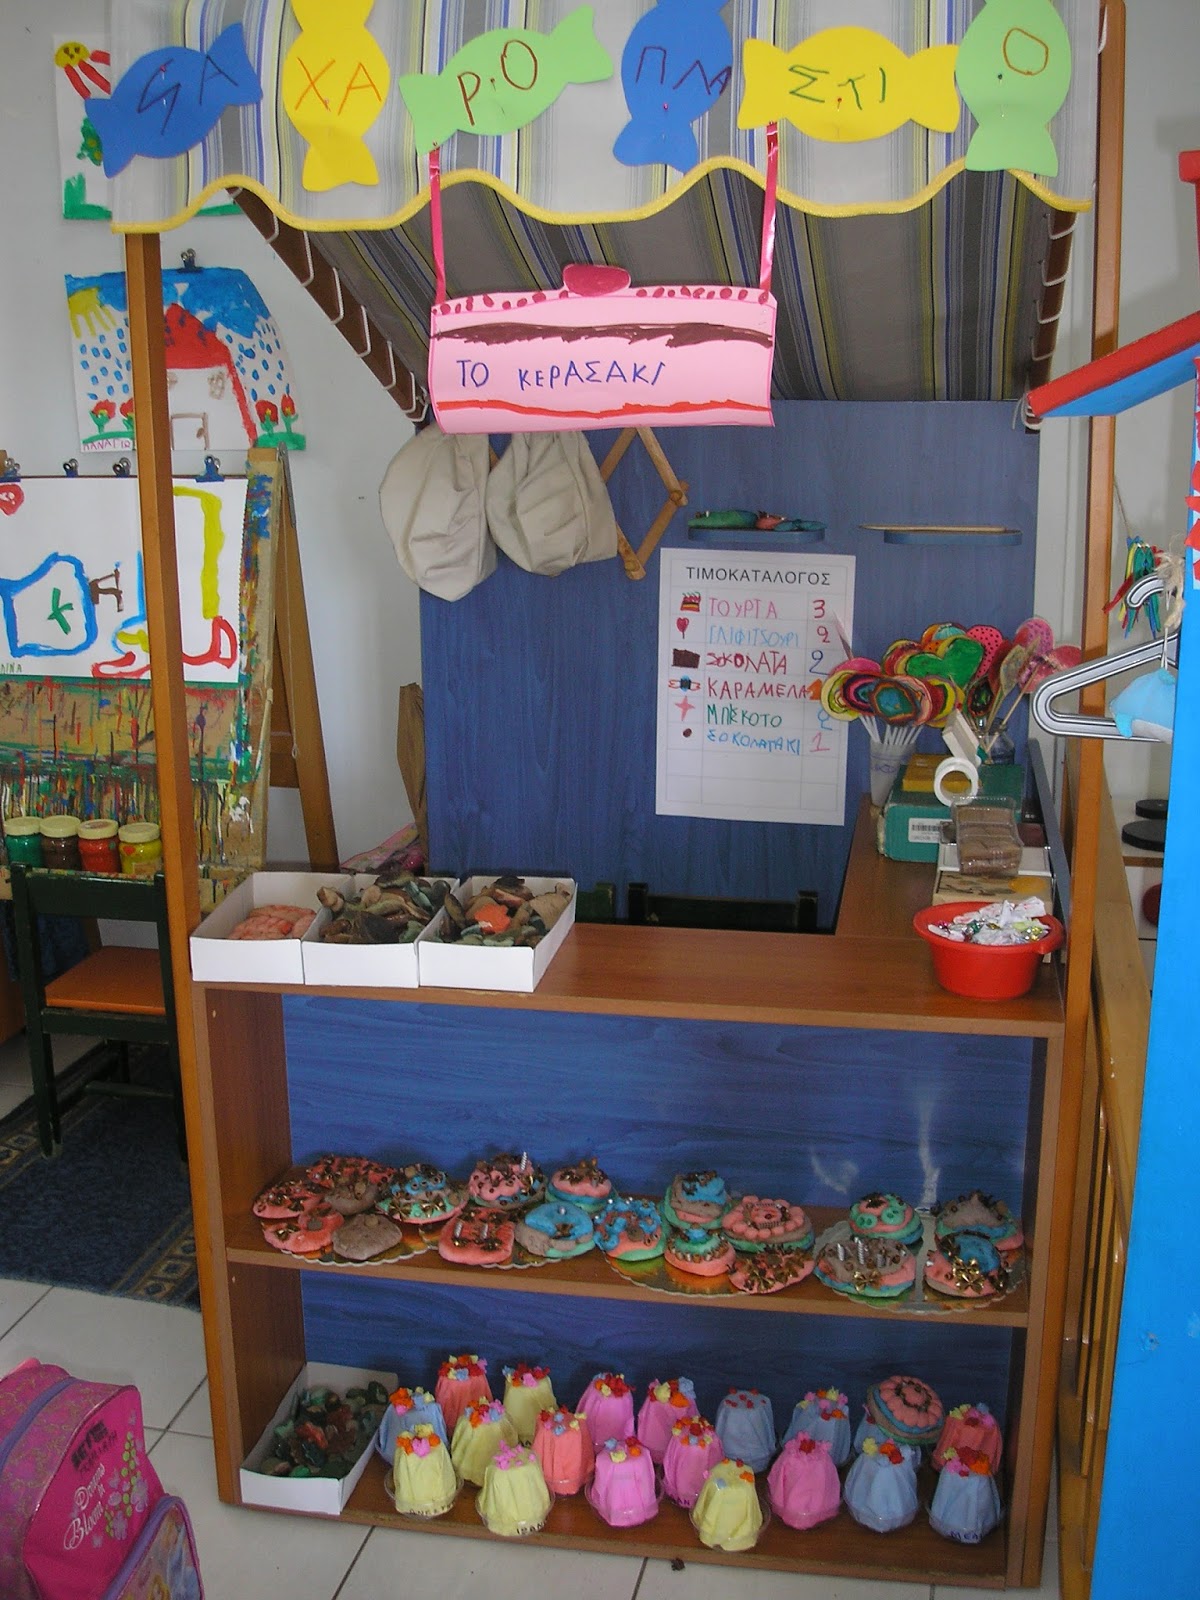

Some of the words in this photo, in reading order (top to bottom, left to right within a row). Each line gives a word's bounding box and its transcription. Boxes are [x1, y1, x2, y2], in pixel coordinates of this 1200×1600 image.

[294, 56, 382, 116] ΧΑ
[456, 359, 490, 388] ΤΟ
[518, 360, 667, 391] ΚΕΡΑΣΑΚΙ
[686, 566, 831, 586] ΤΙΜΟΚΑΤΑΛΟΓΟΣ
[709, 597, 778, 619] ΤΟΥΡΤΑ
[812, 599, 826, 619] 3
[816, 625, 831, 643] 2
[808, 649, 831, 676] 2
[707, 676, 808, 700] ΚΑΡΑΜΕΛΑ
[810, 731, 831, 752] 1
